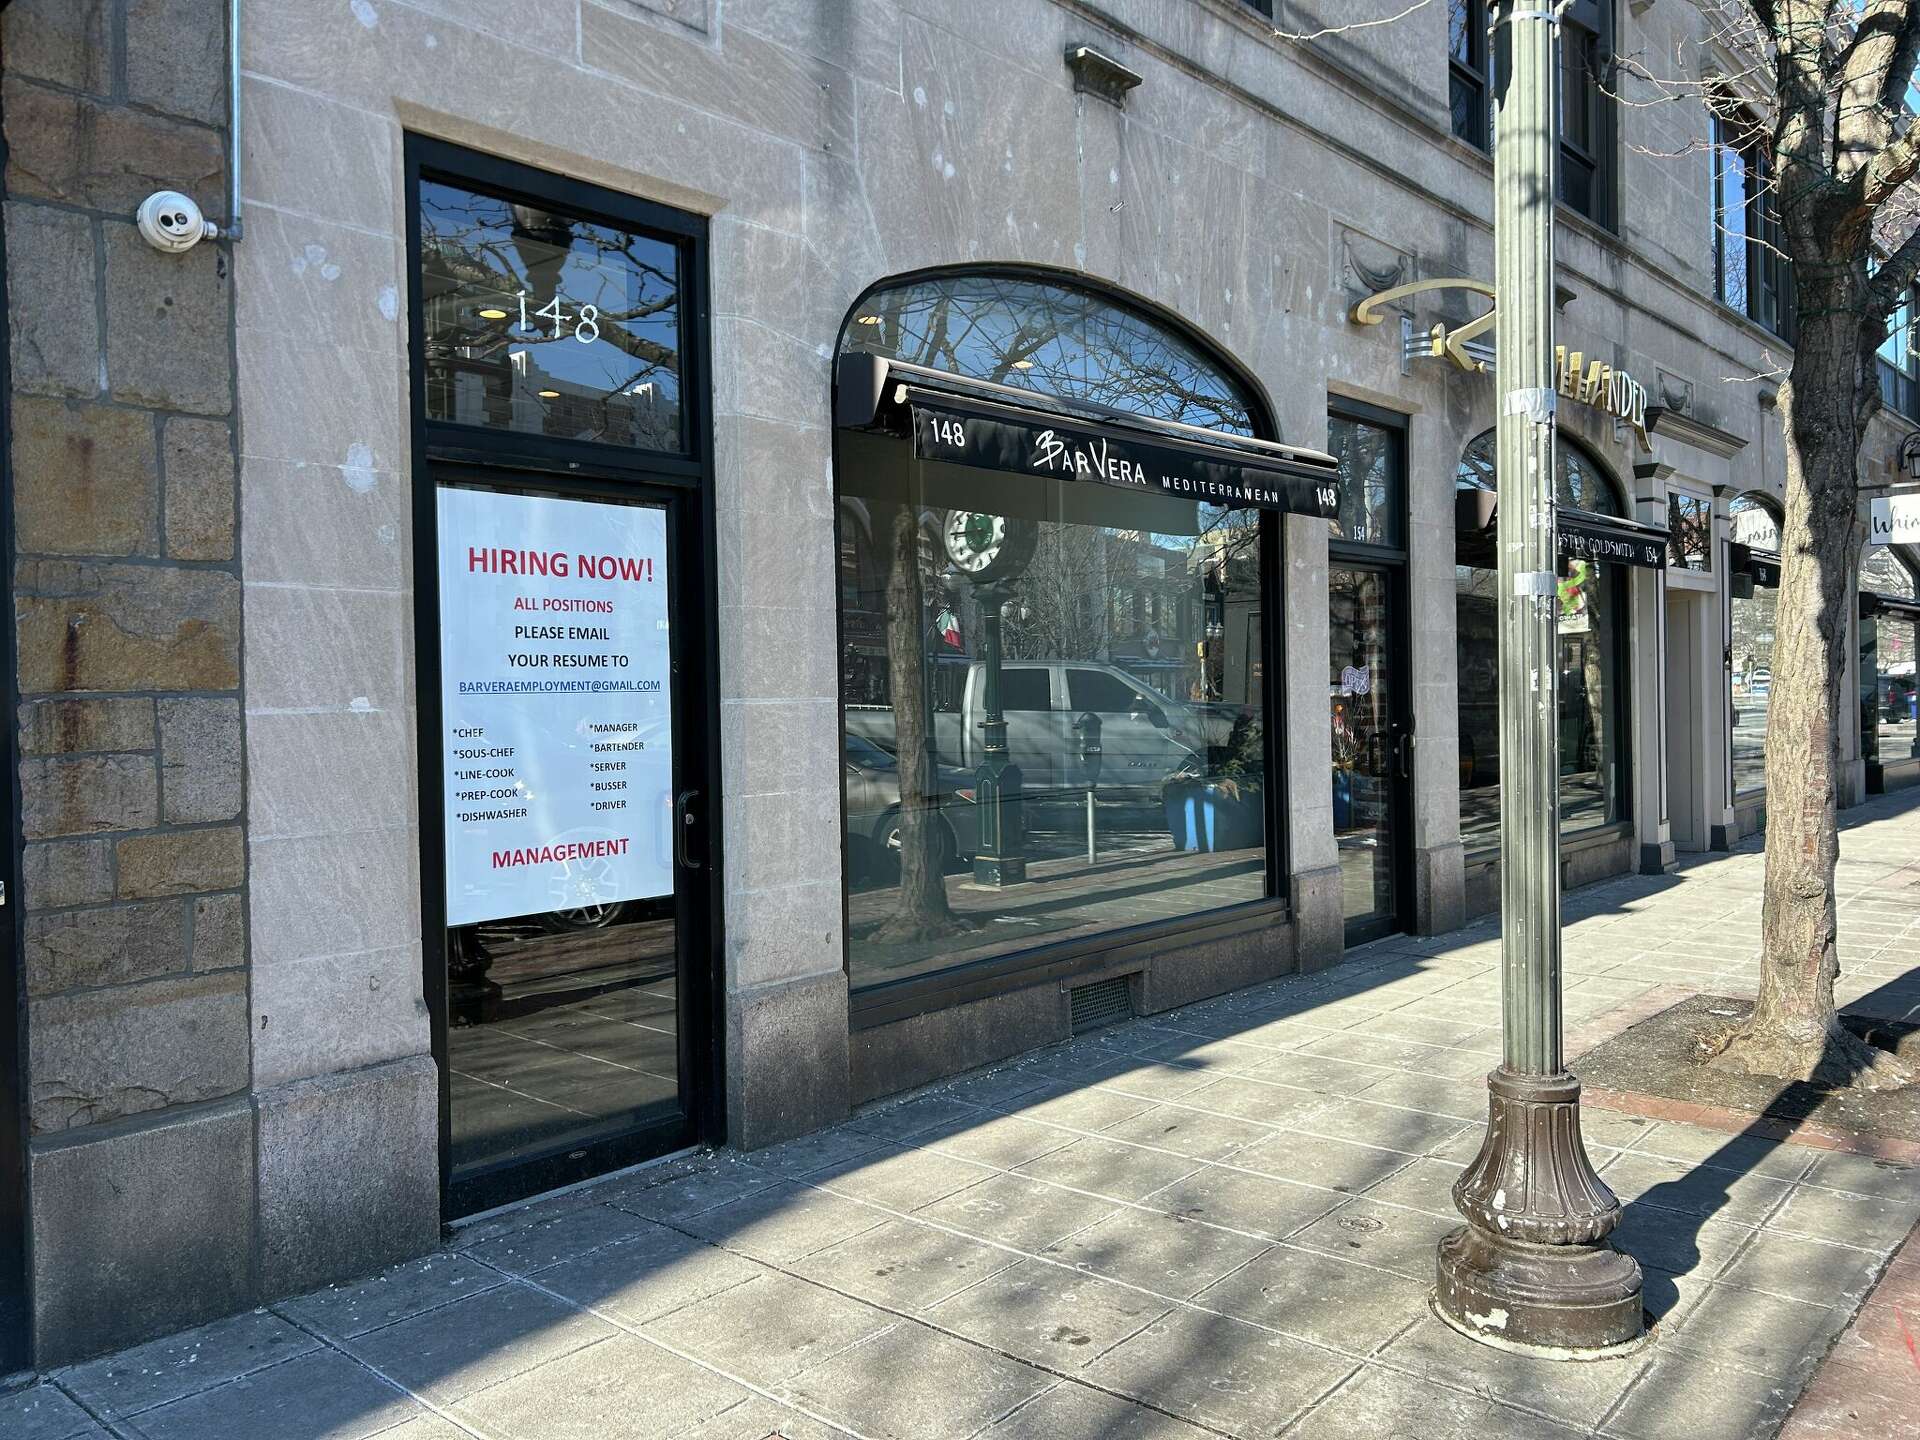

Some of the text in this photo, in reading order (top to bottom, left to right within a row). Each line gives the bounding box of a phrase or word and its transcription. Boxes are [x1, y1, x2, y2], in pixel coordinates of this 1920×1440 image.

[516, 290, 600, 344] 148
[930, 417, 966, 447] 148
[1162, 475, 1279, 504] MEDITERRANEAN
[1316, 487, 1337, 508] 148
[1588, 537, 1635, 558] GOLDSMITH
[468, 547, 653, 583] HIRING NOW!
[514, 597, 614, 613] ALL POSITIONS
[515, 626, 610, 641] PLEASE EMAIL
[508, 654, 629, 668] YOUR RESUME TO
[459, 680, 661, 695] BARVERAEMPLOYMENT@GMAIL.COM
[492, 838, 630, 869] MANAGEMENT
